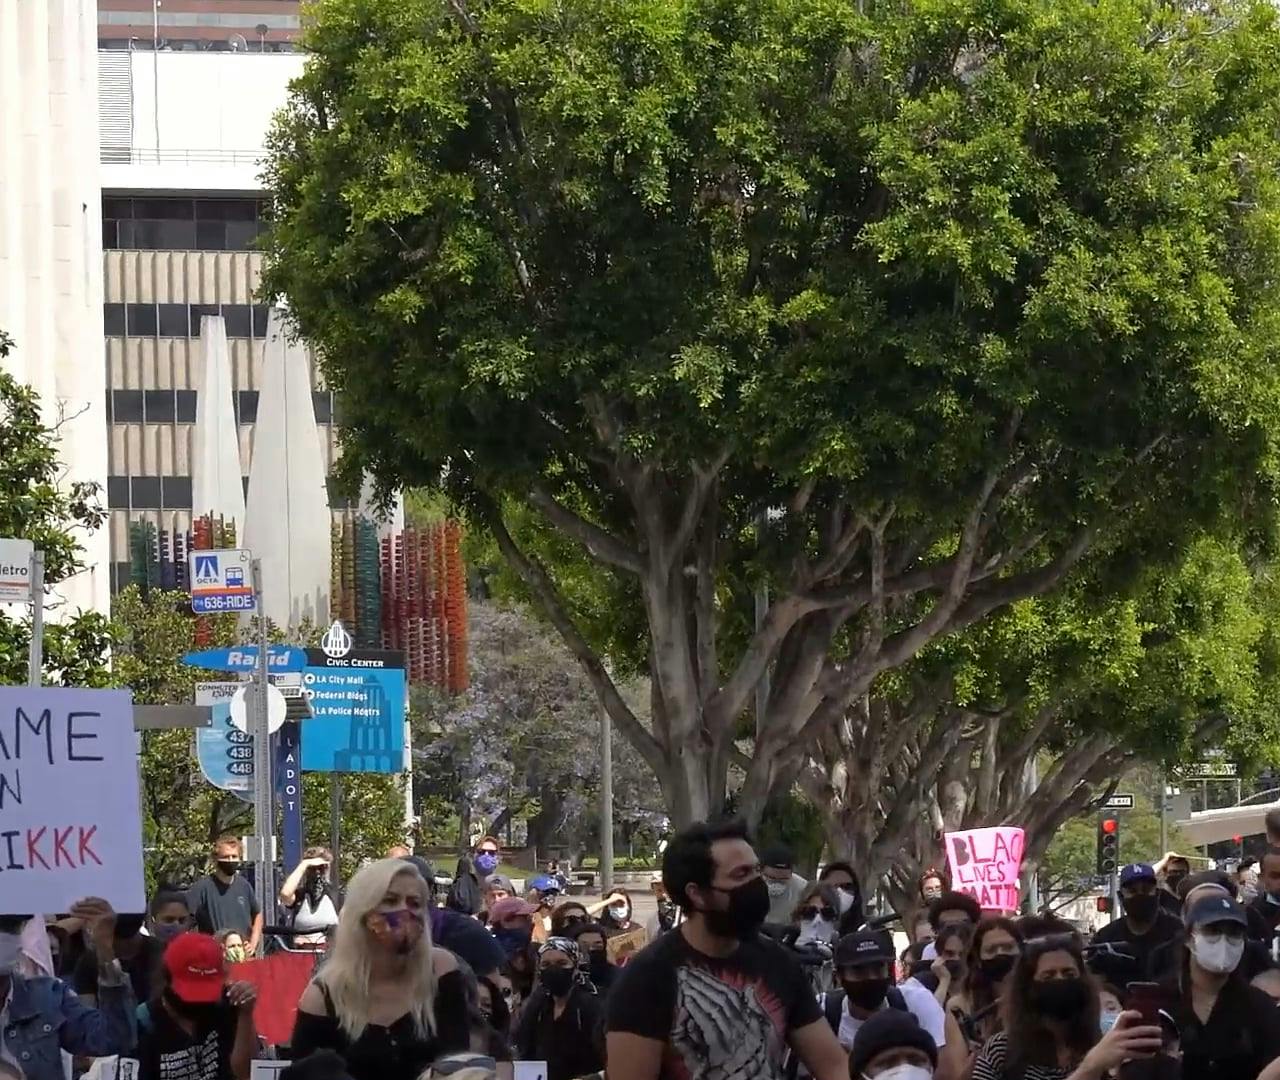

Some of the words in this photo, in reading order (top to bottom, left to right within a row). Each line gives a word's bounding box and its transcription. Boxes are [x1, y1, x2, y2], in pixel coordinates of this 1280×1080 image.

[0, 564, 28, 576] etro
[204, 595, 252, 609] 636-RIDE
[316, 675, 327, 684] LA
[329, 675, 346, 685] City
[347, 675, 364, 685] Hall
[316, 690, 345, 700] Federal
[328, 706, 353, 716] Police
[230, 747, 253, 758] 438
[230, 763, 253, 774] 448
[0, 824, 103, 872] IKKK
[951, 831, 1024, 867] BLAC
[958, 861, 1006, 884] LIVES
